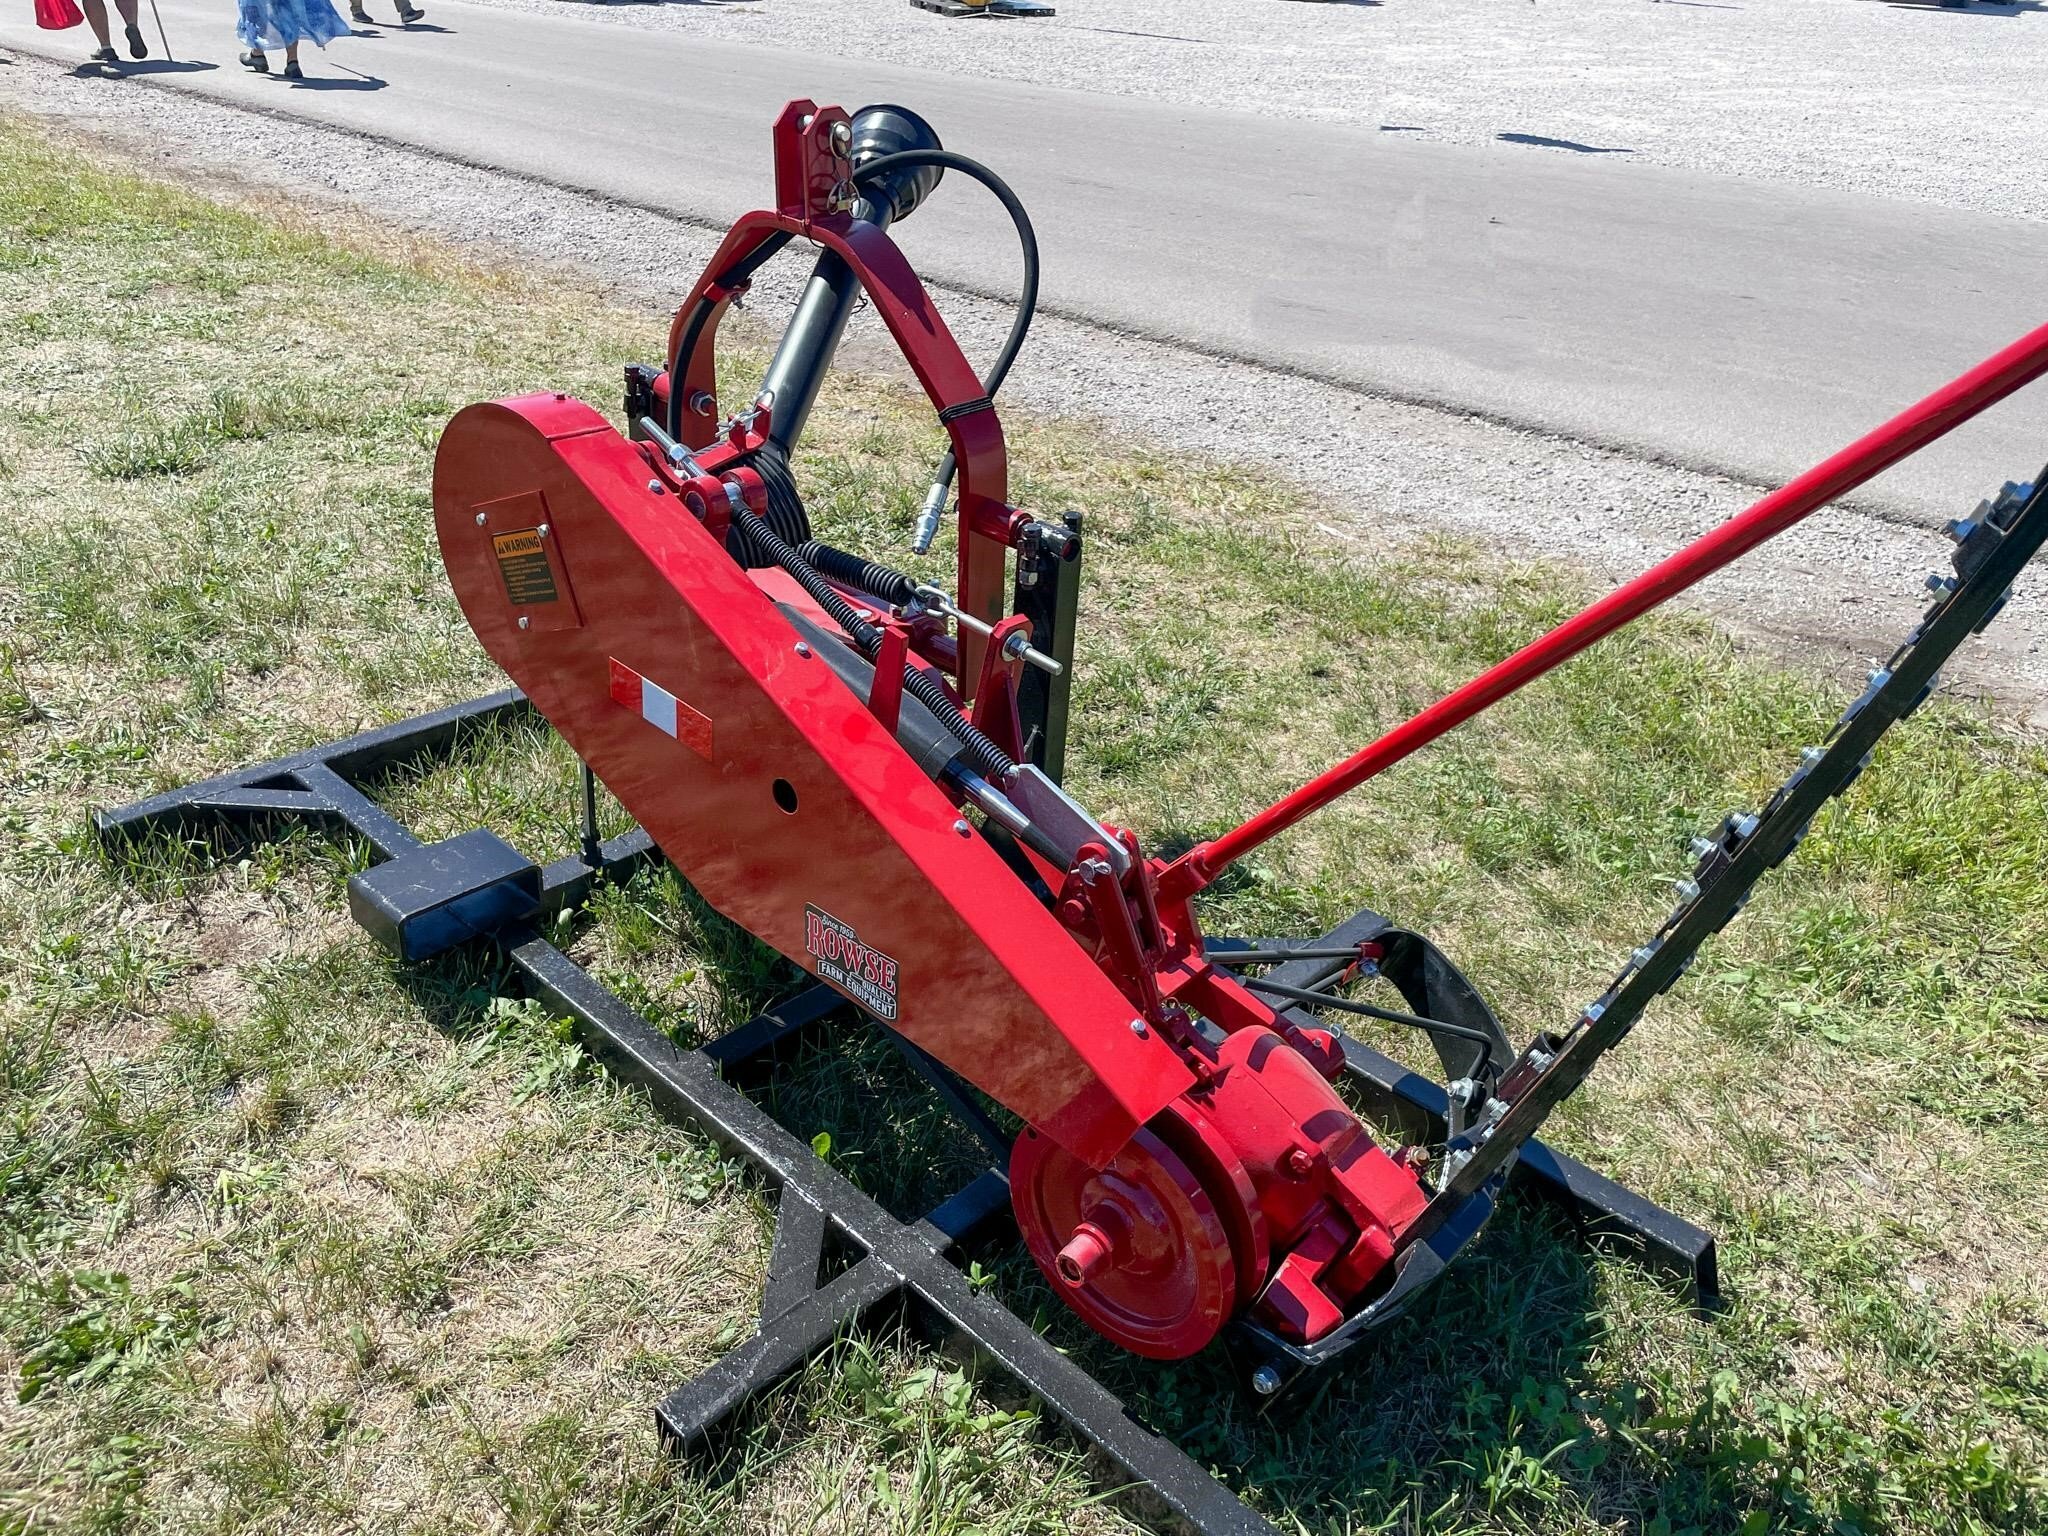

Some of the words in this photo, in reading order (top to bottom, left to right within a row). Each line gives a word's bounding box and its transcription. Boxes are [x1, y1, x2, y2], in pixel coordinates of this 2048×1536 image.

[504, 536, 540, 552] WARNING
[807, 911, 896, 995] ROWSE
[821, 963, 843, 982] FARM
[846, 978, 893, 1017] EQUIPMENT
[862, 981, 892, 1003] QUALITY
